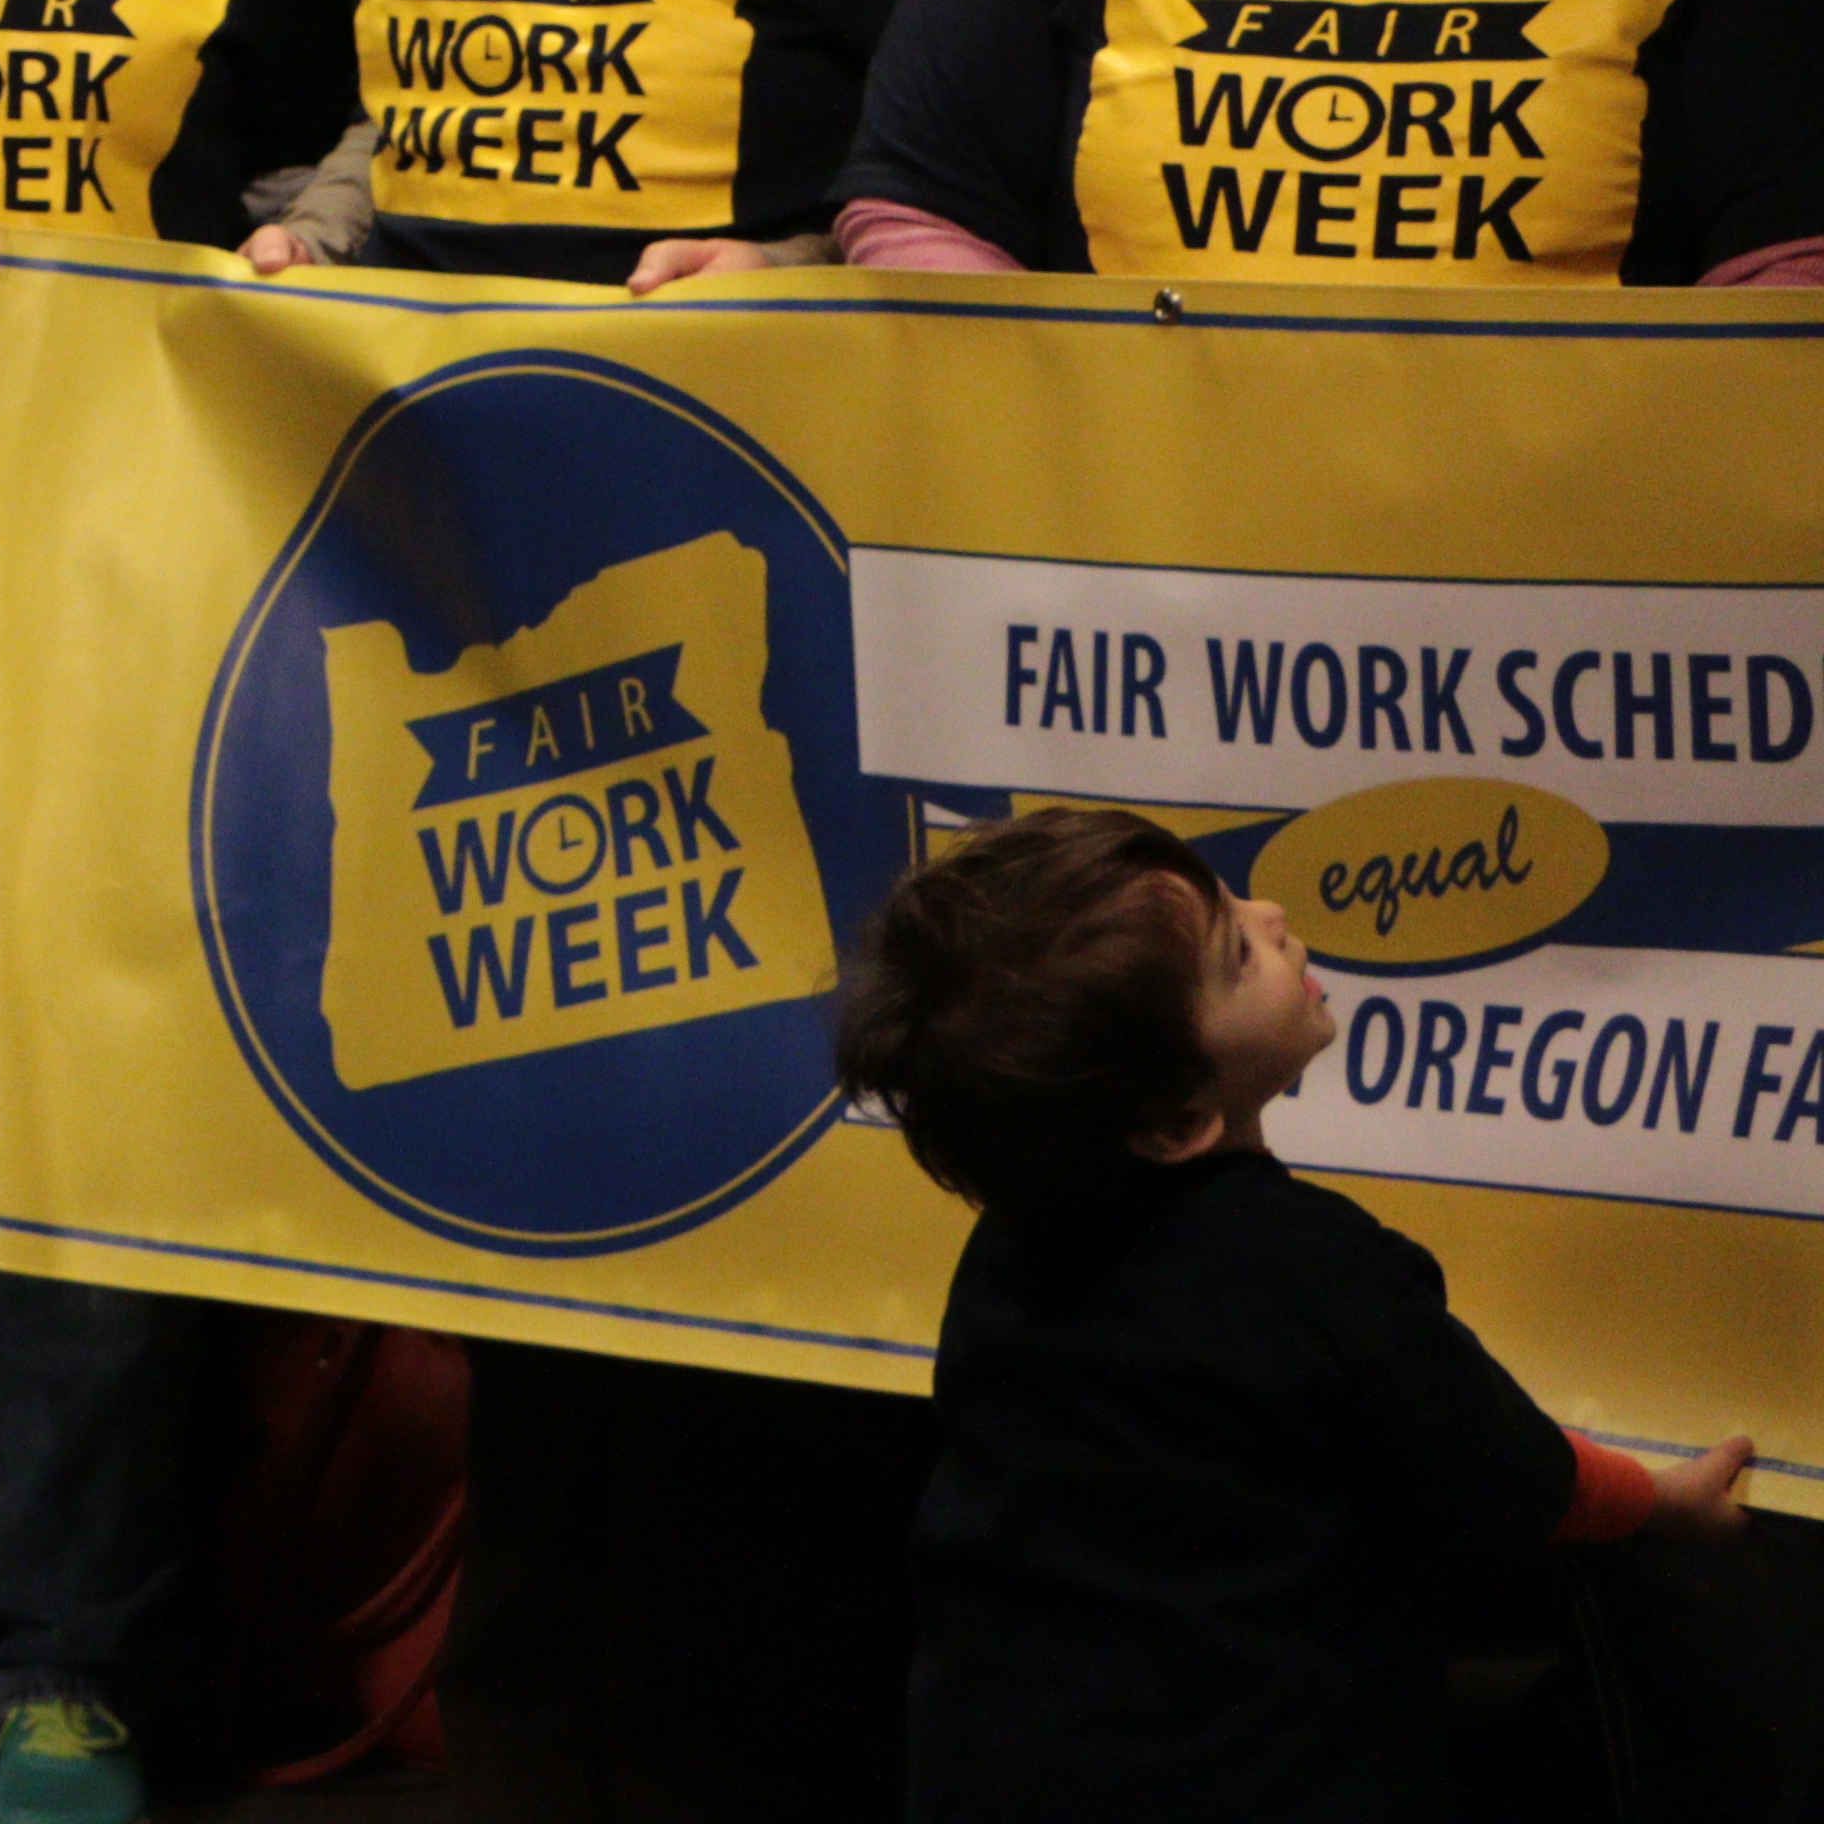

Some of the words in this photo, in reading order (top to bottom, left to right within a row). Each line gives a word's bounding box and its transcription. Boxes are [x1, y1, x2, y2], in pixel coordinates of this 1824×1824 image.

[389, 15, 650, 98] WORK
[1226, 5, 1480, 57] FAIR
[373, 107, 643, 191] WEEK
[1174, 67, 1545, 162] WORK
[1162, 163, 1543, 262] WEEK
[467, 677, 654, 781] FAIR
[1005, 624, 1168, 739] FAIR
[1206, 638, 1475, 756] WORK
[1496, 650, 1824, 764] SCHED
[418, 755, 743, 916] WORK
[1320, 805, 1533, 938] equal
[428, 867, 760, 1028] WEEK
[1346, 995, 1720, 1134] OREGON
